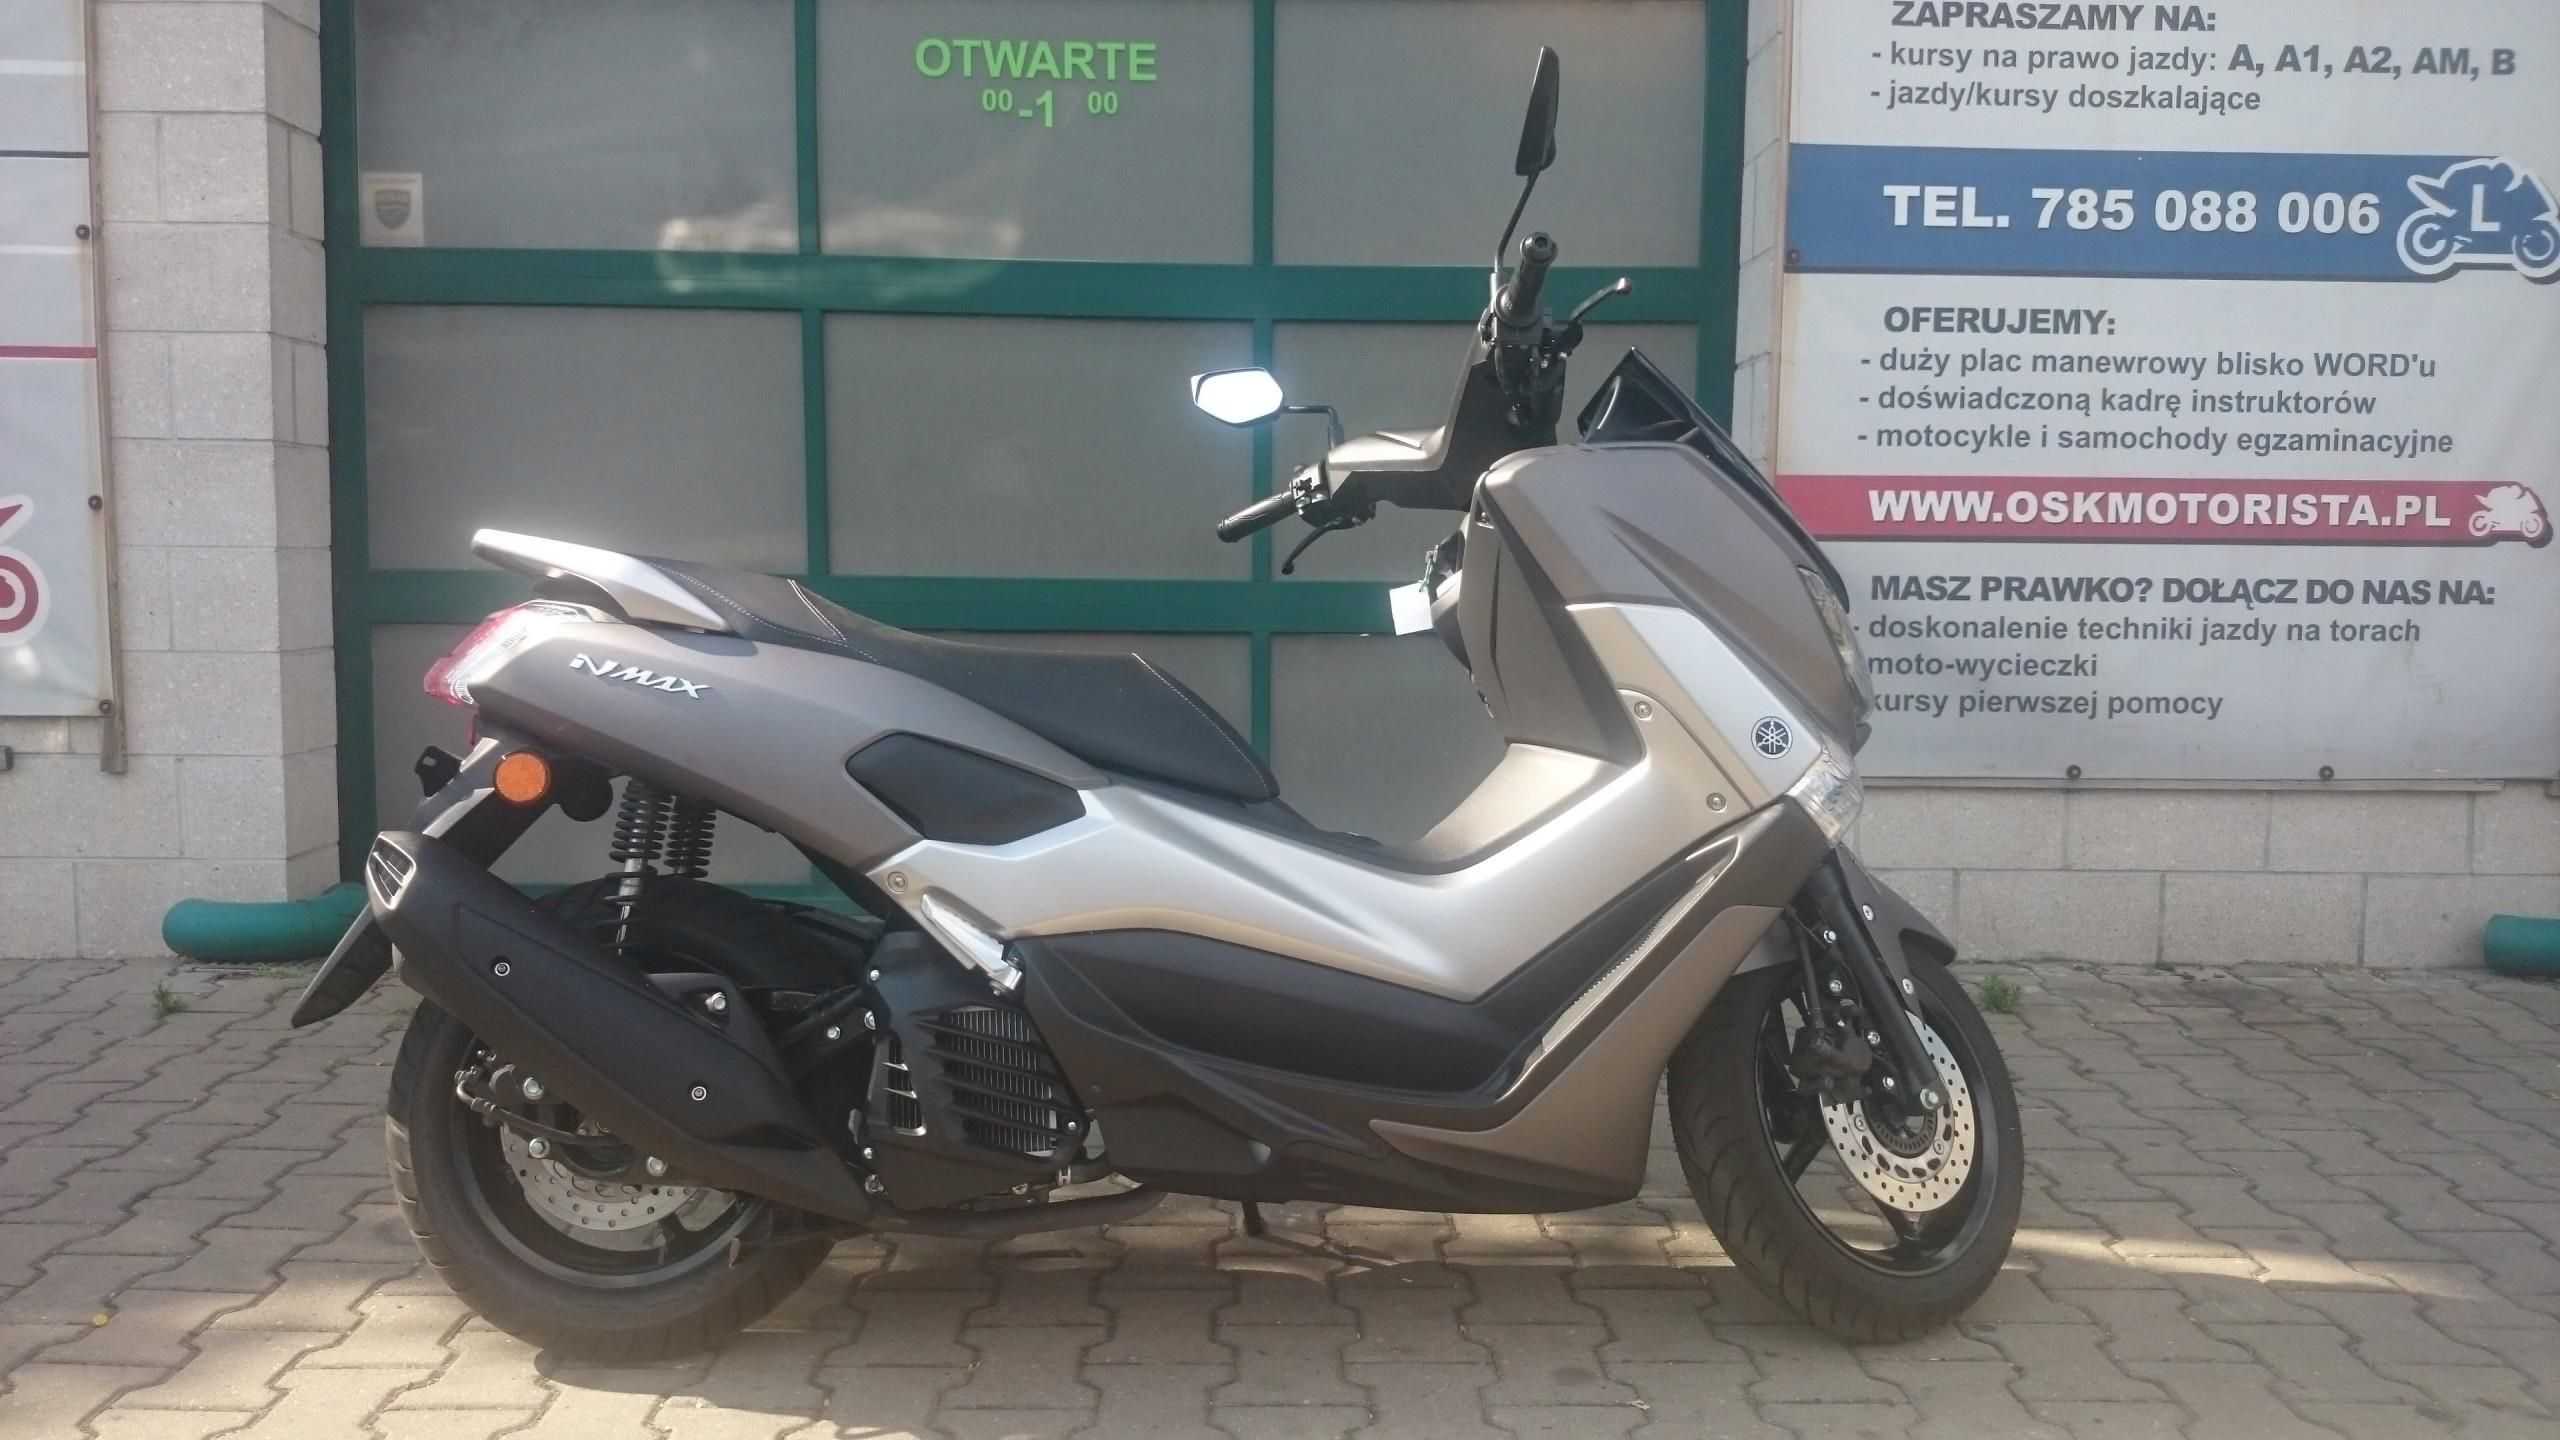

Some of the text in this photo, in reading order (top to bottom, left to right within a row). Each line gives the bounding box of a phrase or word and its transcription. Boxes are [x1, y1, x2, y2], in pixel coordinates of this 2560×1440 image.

[1891, 1, 2216, 32] ZAPRASZAMY NA:
[915, 38, 1158, 82] OTWARTE
[1890, 41, 1973, 73] kursy
[1983, 49, 2017, 68] na
[2028, 50, 2119, 74] prawo
[2126, 46, 2216, 76] jazdy:
[2227, 43, 2264, 77] A,
[2274, 45, 2332, 79] A1,
[2343, 46, 2401, 80] A2,
[2411, 47, 2479, 82] AM,
[2490, 48, 2516, 75] B
[982, 89, 1012, 112] 00
[1087, 91, 1118, 115] 00
[1887, 80, 2059, 113] jazdy/kursy
[2068, 84, 2261, 116] doszkalające
[1883, 184, 2380, 235] TEL. 785 088 006
[2470, 184, 2501, 232] L
[1883, 306, 2117, 336] OFERUJEMY:
[1879, 347, 1951, 378] duży
[1960, 348, 2022, 378] plac
[2031, 354, 2207, 381] manewrowy
[2217, 352, 2304, 377] blisko
[2314, 352, 2436, 378] WORD'u
[1878, 384, 2091, 416] doświadczoną
[2101, 388, 2181, 418] kadrę
[2192, 389, 2377, 415] instruktorów
[1876, 424, 2031, 455] motocykle
[2041, 425, 2048, 448] i
[2057, 426, 2228, 456] samochody
[2236, 428, 2454, 459] egzaminacyjne
[1868, 488, 2452, 529] WWW.OSKMOTORISTA.PL
[1871, 575, 2496, 610] MASZ PRAWKO? DOŁĄCZ DO NAS NA:
[1868, 615, 2068, 640] doskonalenie
[2077, 617, 2192, 641] techniki
[2199, 618, 2277, 647] jazdy
[2287, 623, 2320, 642] na
[2330, 619, 2421, 643] torach
[570, 653, 712, 700] NMAX
[1868, 653, 2097, 682] moto-wycieczki
[1959, 690, 2098, 720] pierwszej
[2108, 695, 2224, 721] pomocy
